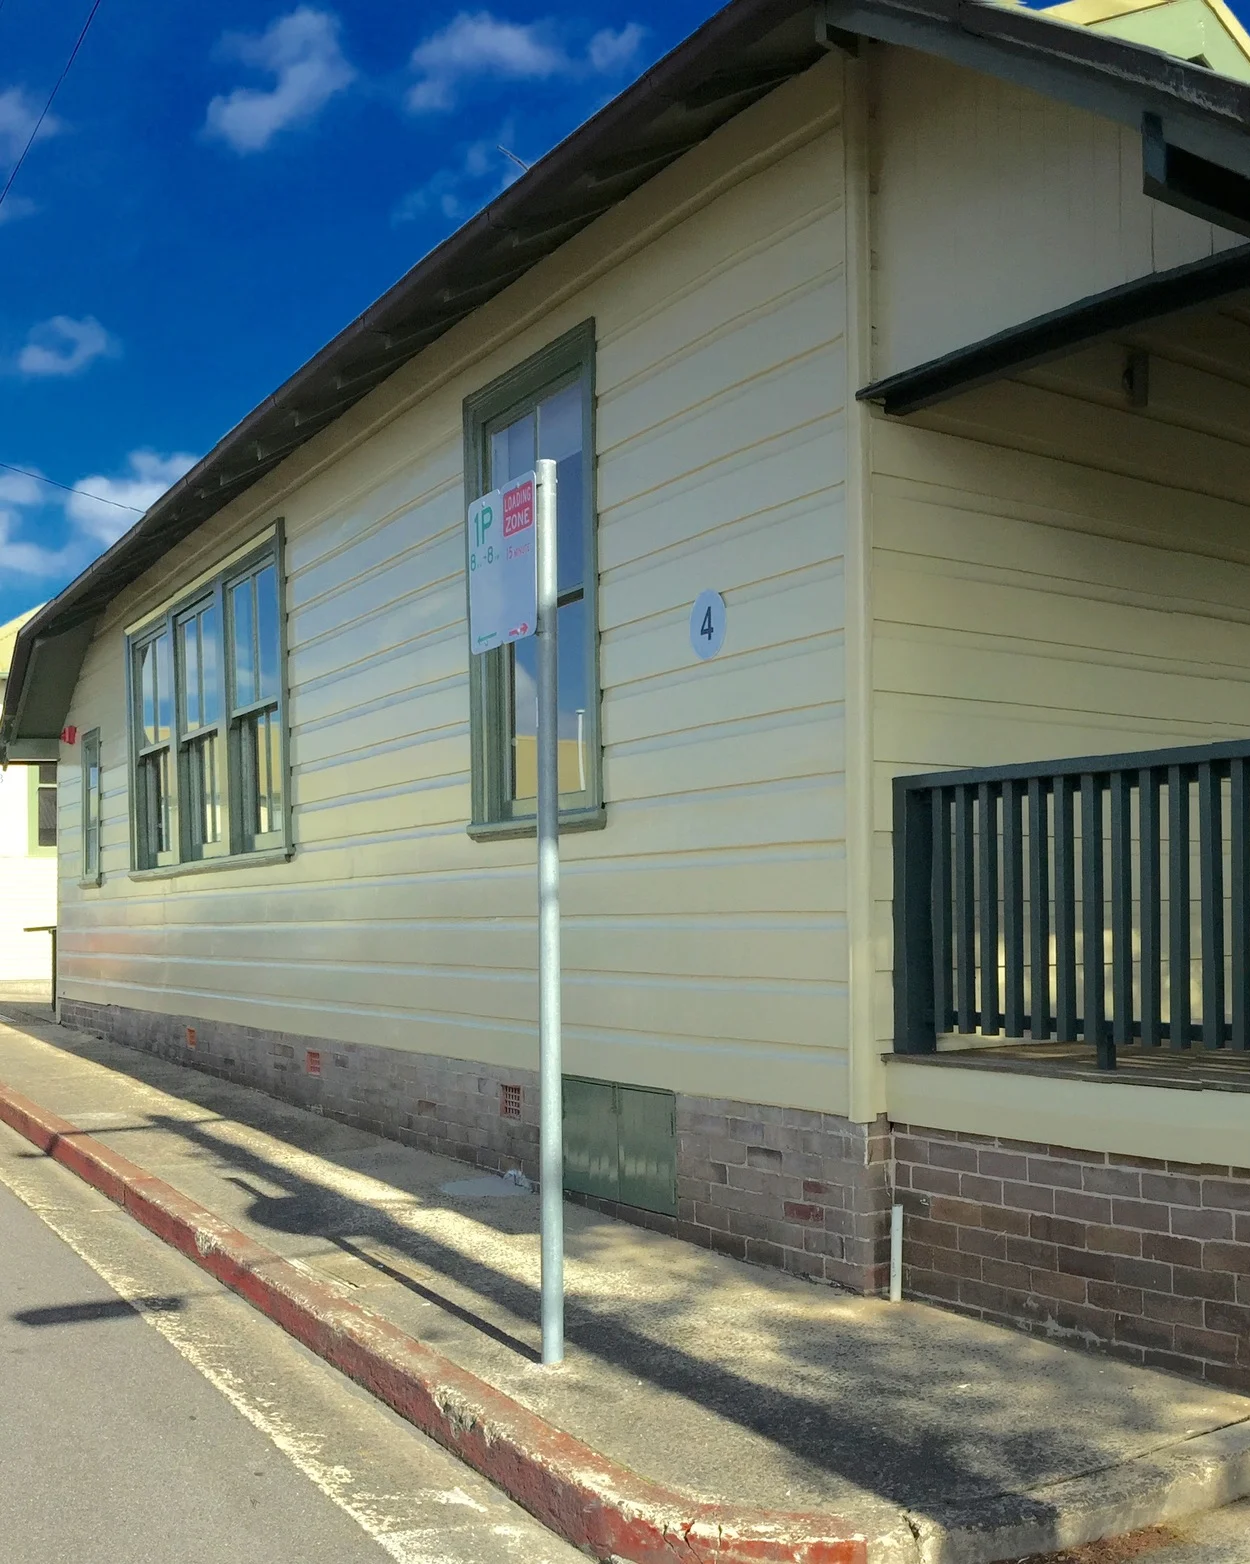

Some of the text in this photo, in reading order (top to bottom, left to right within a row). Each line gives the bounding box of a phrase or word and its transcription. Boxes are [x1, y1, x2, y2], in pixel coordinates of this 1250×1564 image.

[504, 486, 531, 512] LOADING
[474, 506, 493, 548] 1P
[505, 507, 530, 533] ZONE
[700, 606, 714, 641] 4
